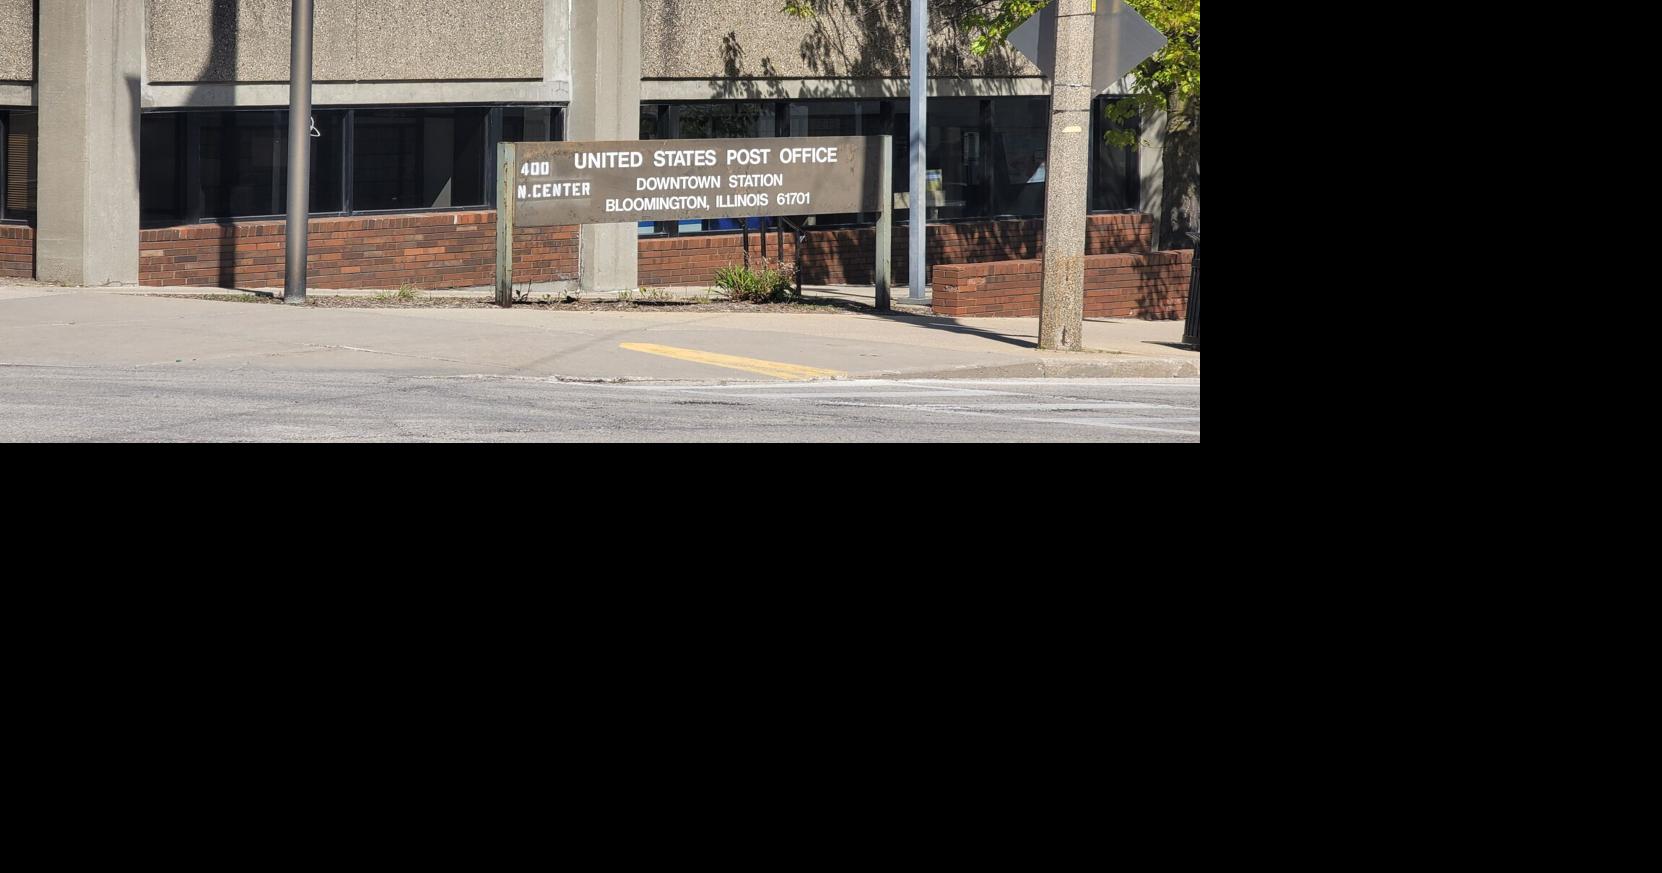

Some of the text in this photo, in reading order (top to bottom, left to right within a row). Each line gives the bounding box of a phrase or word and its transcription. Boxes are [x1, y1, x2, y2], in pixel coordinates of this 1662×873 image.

[575, 147, 838, 169] UNITED STATES POST OFFICE
[520, 161, 550, 176] 400
[637, 173, 783, 190] DOWNTOWN STATION
[606, 192, 810, 212] BLOOMINGTON, ILLINOIS 61701
